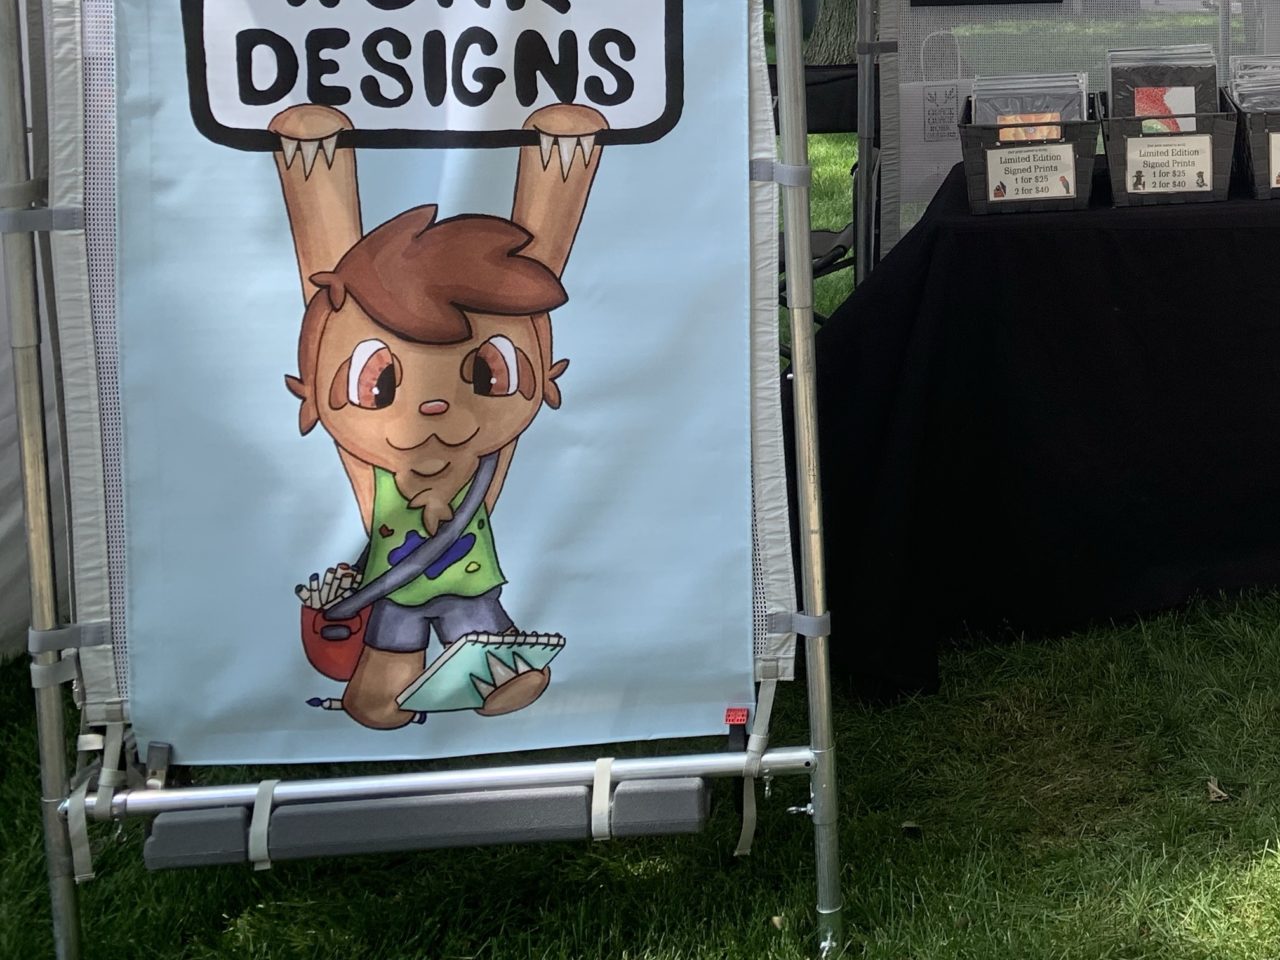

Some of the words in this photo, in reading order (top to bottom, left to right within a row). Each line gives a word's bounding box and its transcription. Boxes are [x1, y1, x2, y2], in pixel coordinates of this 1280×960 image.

[235, 26, 636, 107] DESIGNS
[1139, 149, 1168, 157] Limited
[1000, 155, 1030, 164] Limited
[1032, 154, 1062, 162] Edition
[1143, 160, 1170, 168] Signed
[1004, 166, 1032, 175] Signed
[1035, 186, 1049, 194] $40
